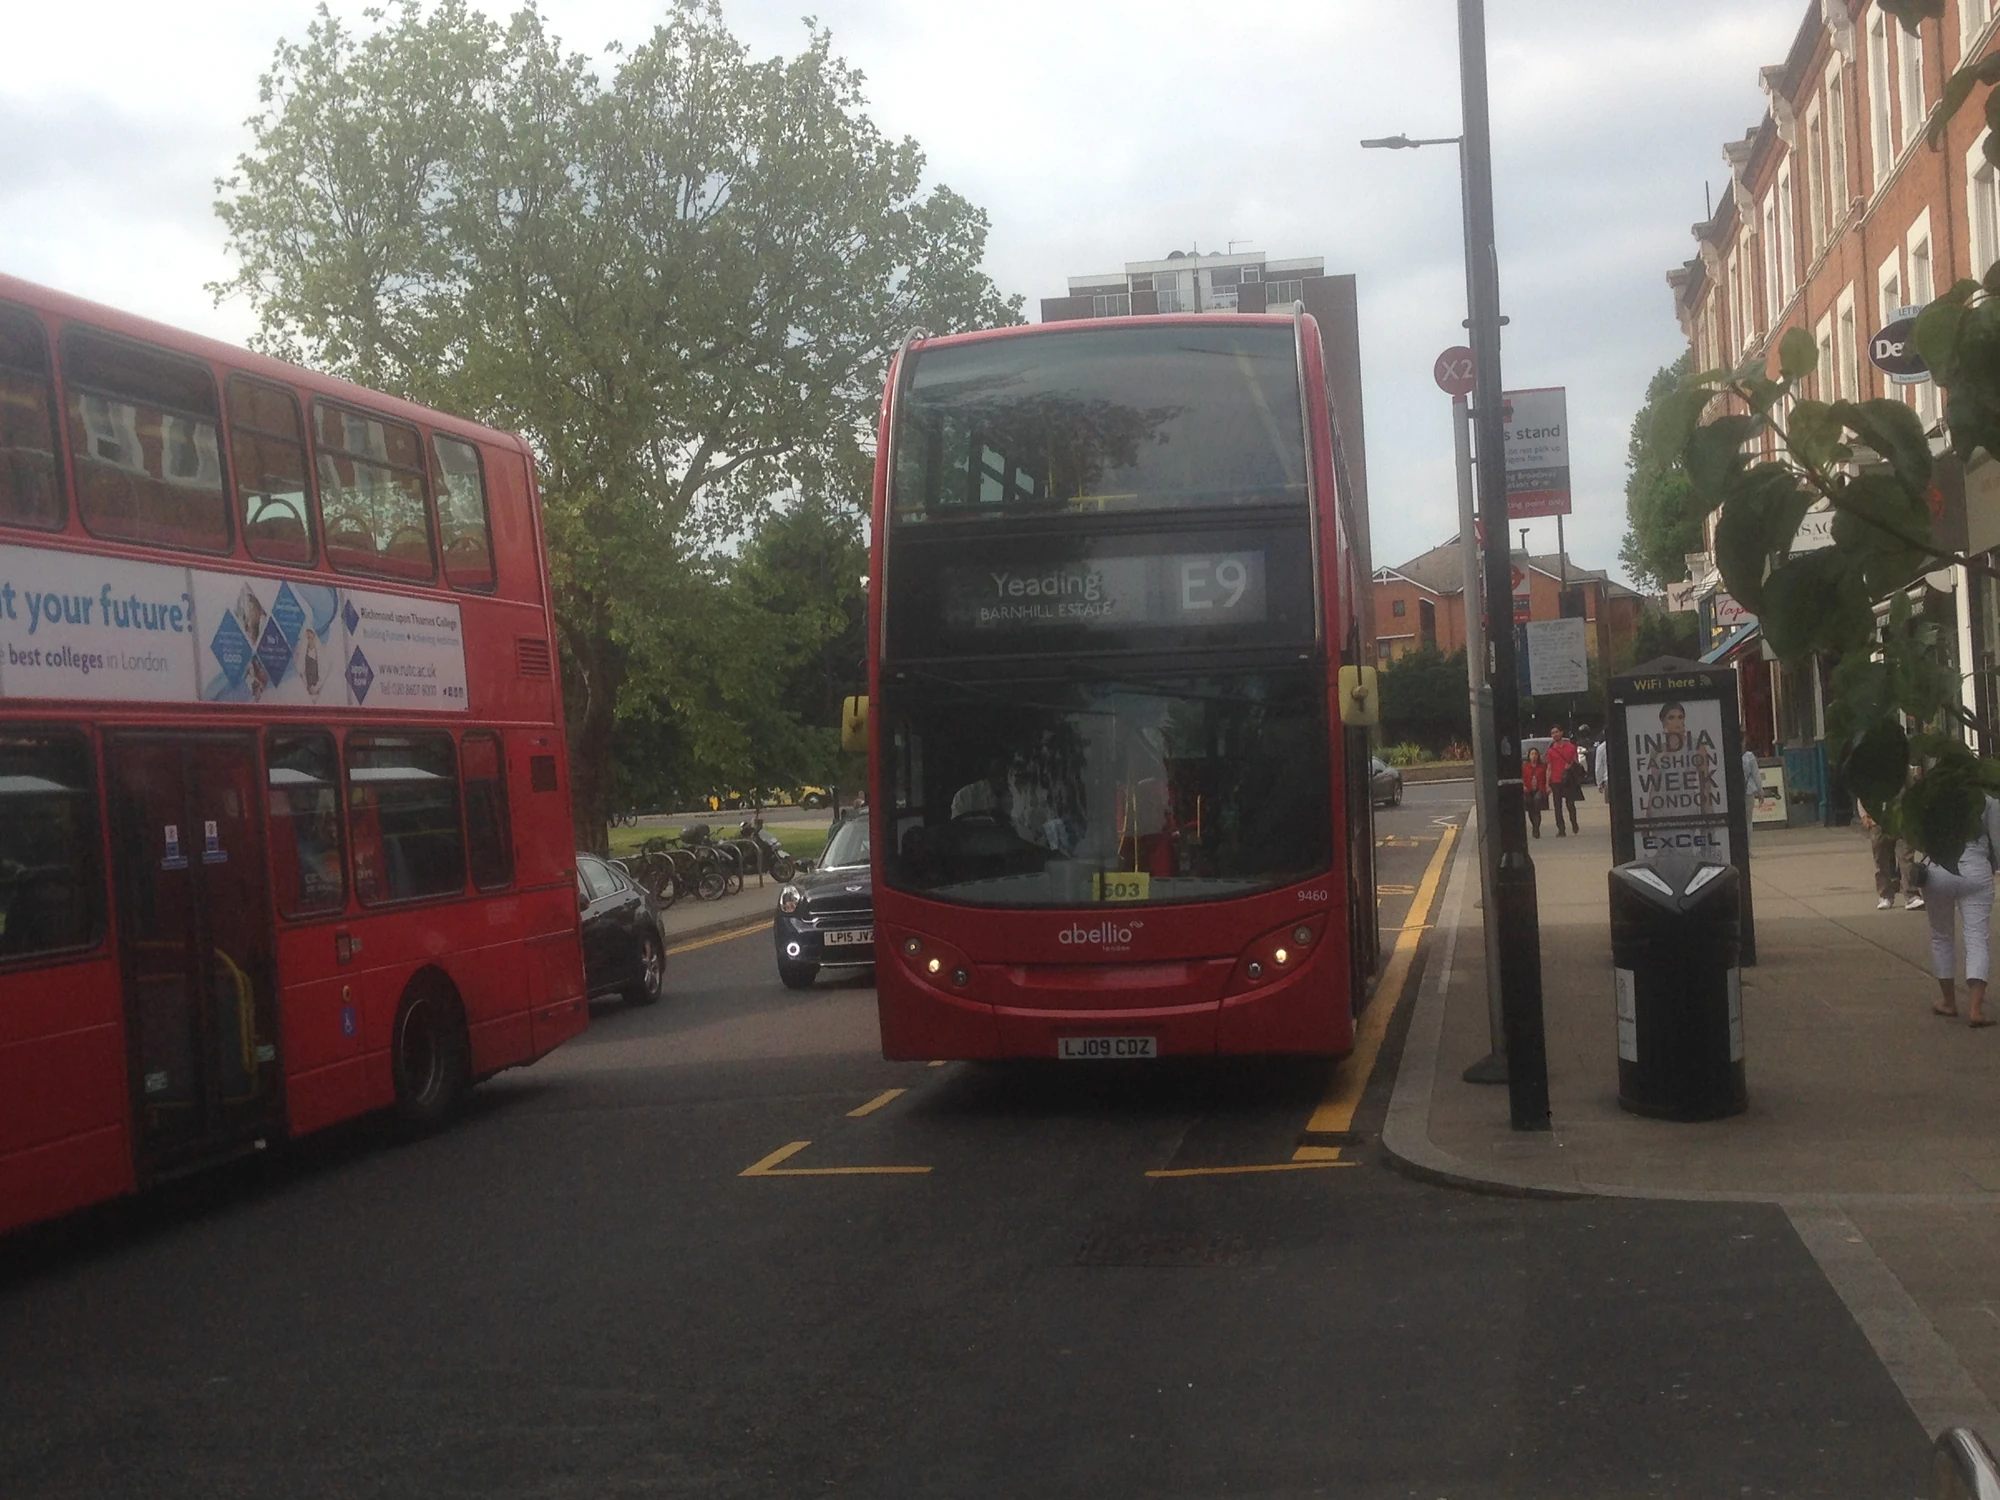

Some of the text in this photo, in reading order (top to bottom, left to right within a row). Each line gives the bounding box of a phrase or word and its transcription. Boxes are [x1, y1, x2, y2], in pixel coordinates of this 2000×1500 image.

[1898, 307, 1911, 316] LET
[1875, 339, 1905, 359] De
[1441, 359, 1474, 381] X2
[1516, 424, 1560, 440] stand
[1518, 472, 1557, 480] Broadway
[1525, 500, 1546, 509] point
[1548, 498, 1566, 507] only
[990, 559, 1247, 609] Yeading E9
[25, 591, 93, 635] your
[100, 583, 194, 633] future?
[980, 601, 1112, 621] BARNHILL ESTATE
[360, 607, 458, 631] Richmond upon Thames College
[8, 643, 41, 666] best
[45, 646, 103, 675] colleges
[107, 653, 119, 669] in
[121, 652, 169, 672] London
[1634, 677, 1696, 691] WiFi here
[1635, 730, 1716, 755] INDIA
[1636, 753, 1719, 771] FASHION
[1638, 769, 1719, 793] WEEK
[1639, 792, 1721, 811] LONDON
[1297, 889, 1328, 902] 9460
[830, 931, 854, 943] LP15
[1058, 921, 1132, 945] abellio
[1064, 1039, 1150, 1057] LJ09 CDZ
